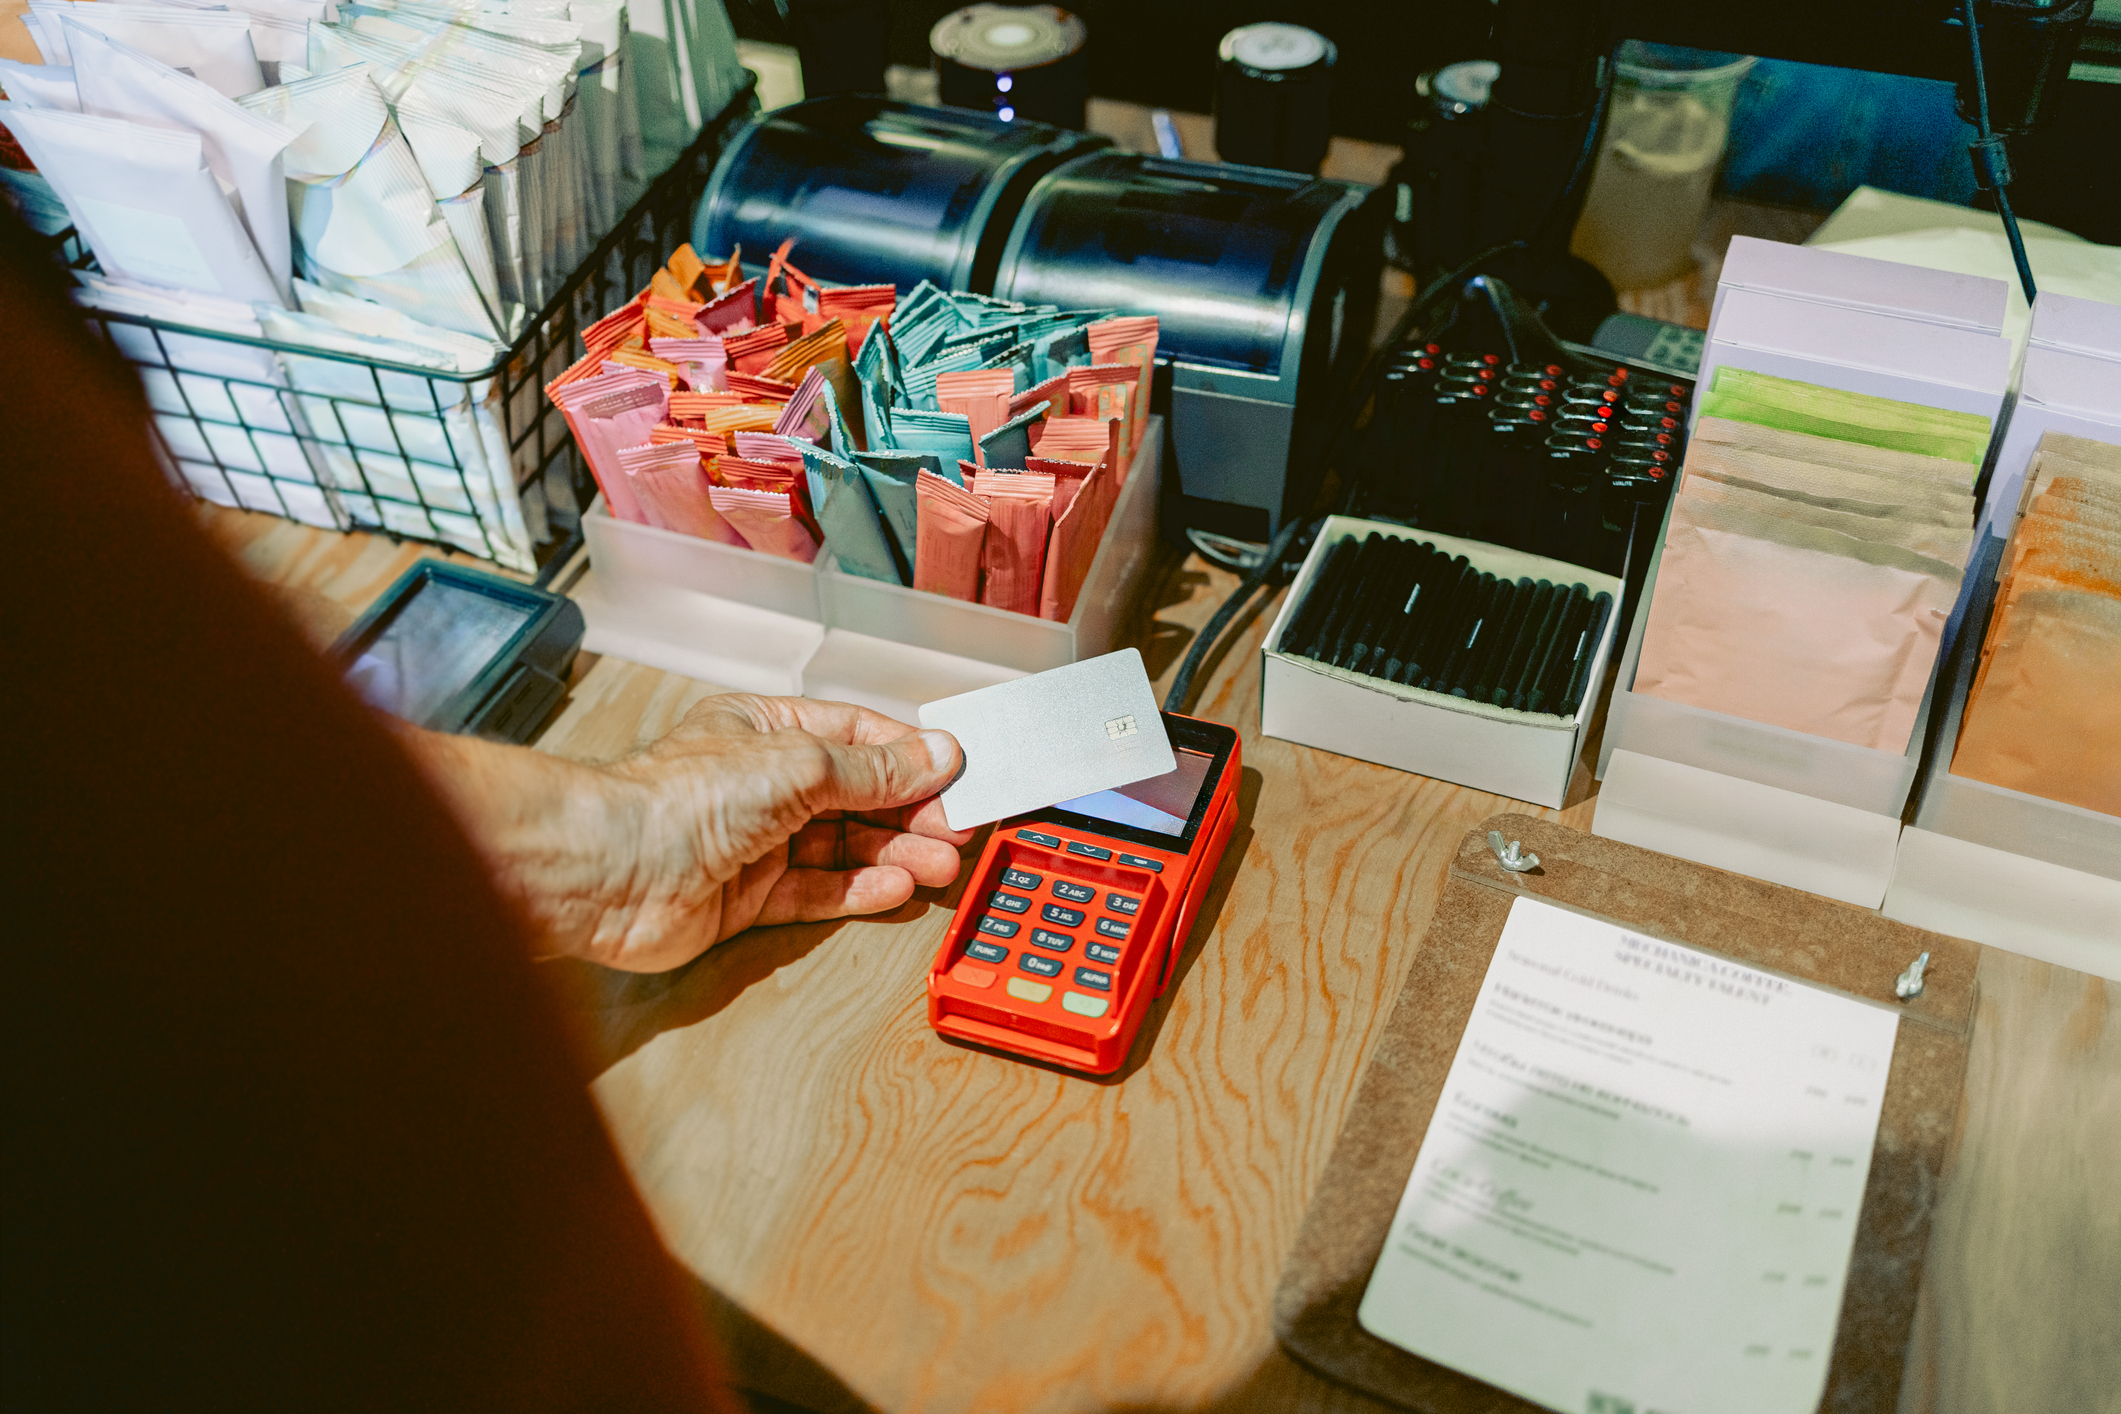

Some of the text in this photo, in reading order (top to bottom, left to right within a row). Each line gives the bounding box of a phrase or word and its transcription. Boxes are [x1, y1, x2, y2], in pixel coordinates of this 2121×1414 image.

[1009, 872, 1031, 885] 1 QZ
[1058, 884, 1086, 898] 2 ABC
[996, 895, 1023, 908] 4 GHI
[1113, 897, 1139, 911] 3 DEF
[1050, 907, 1074, 922] 5 JKL
[984, 918, 1010, 933] 7 PRS
[1100, 920, 1111, 930] 6
[1037, 931, 1065, 946] 8 TUV
[974, 944, 998, 957] FUNC
[1090, 944, 1101, 955] 9
[1027, 957, 1038, 968] 0
[1081, 971, 1109, 985] ALPHA
